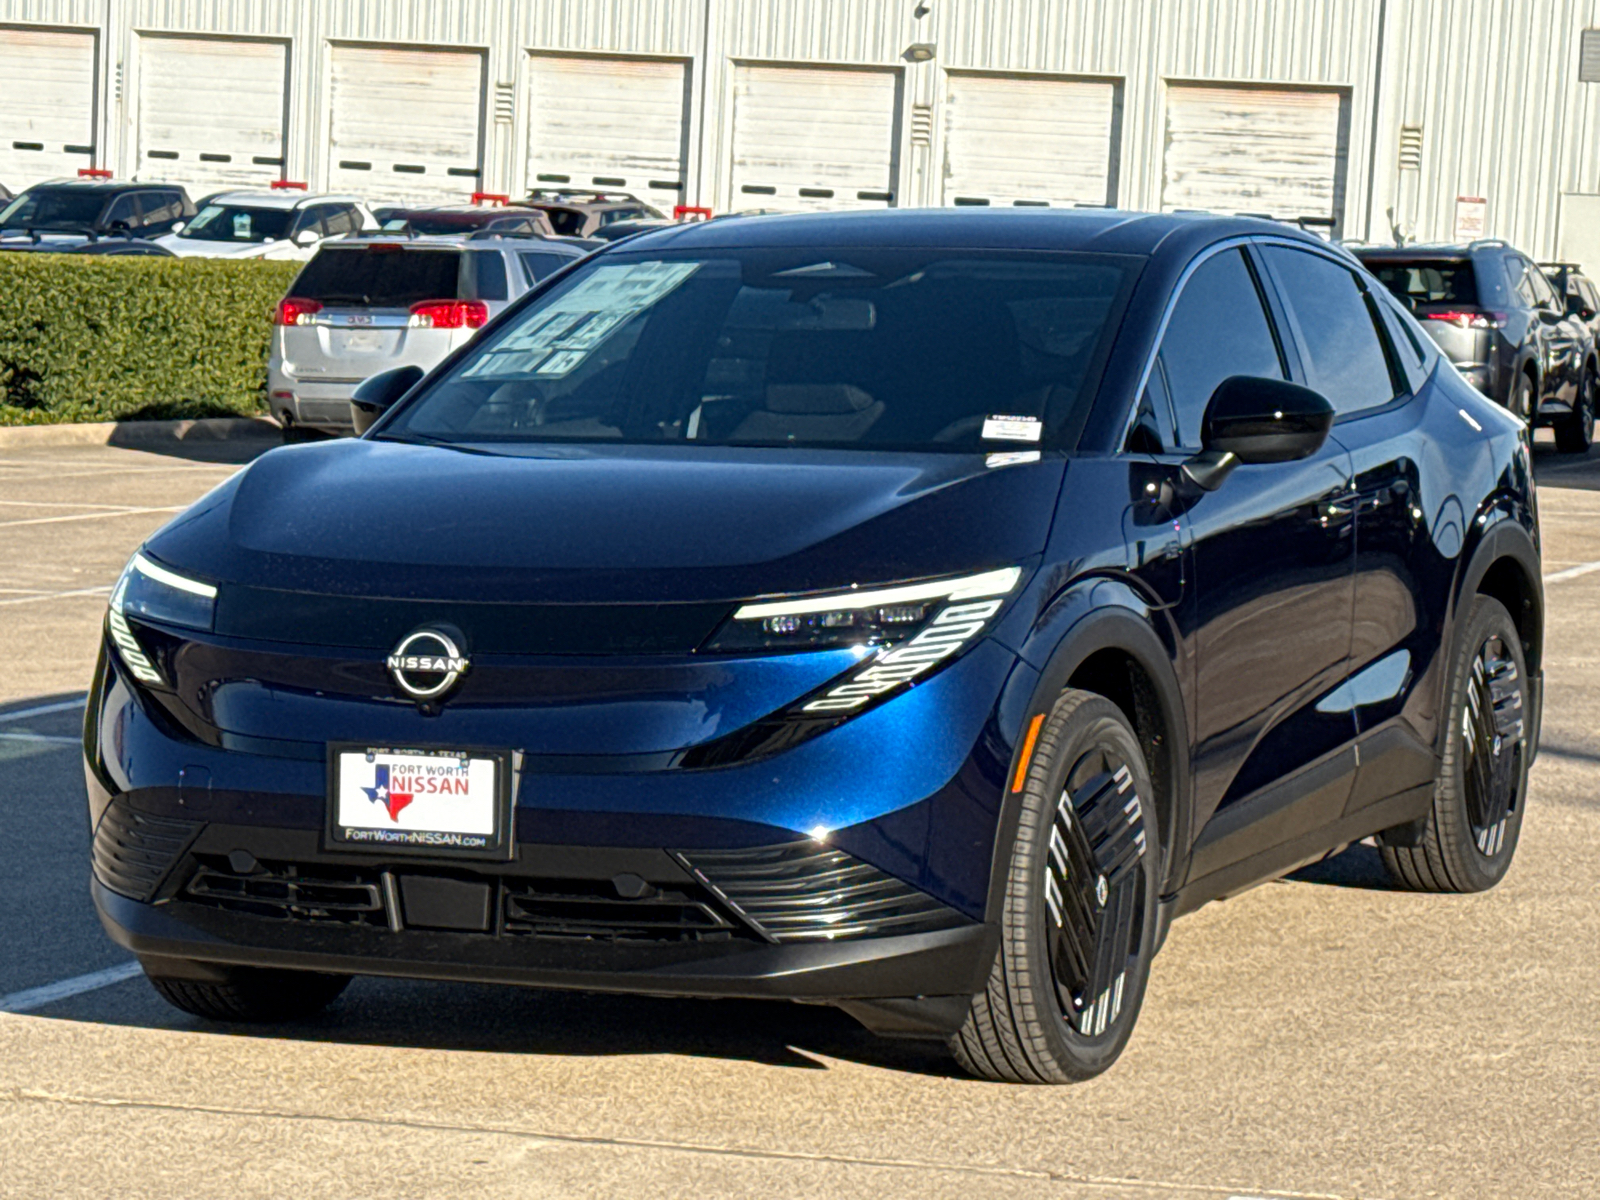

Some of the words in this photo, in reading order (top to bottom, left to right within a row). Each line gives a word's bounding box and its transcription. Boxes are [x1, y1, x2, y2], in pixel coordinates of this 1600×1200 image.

[388, 656, 463, 672] NISSAN
[392, 764, 422, 775] FORT
[425, 765, 469, 777] WORTH
[392, 775, 469, 795] NISSAN
